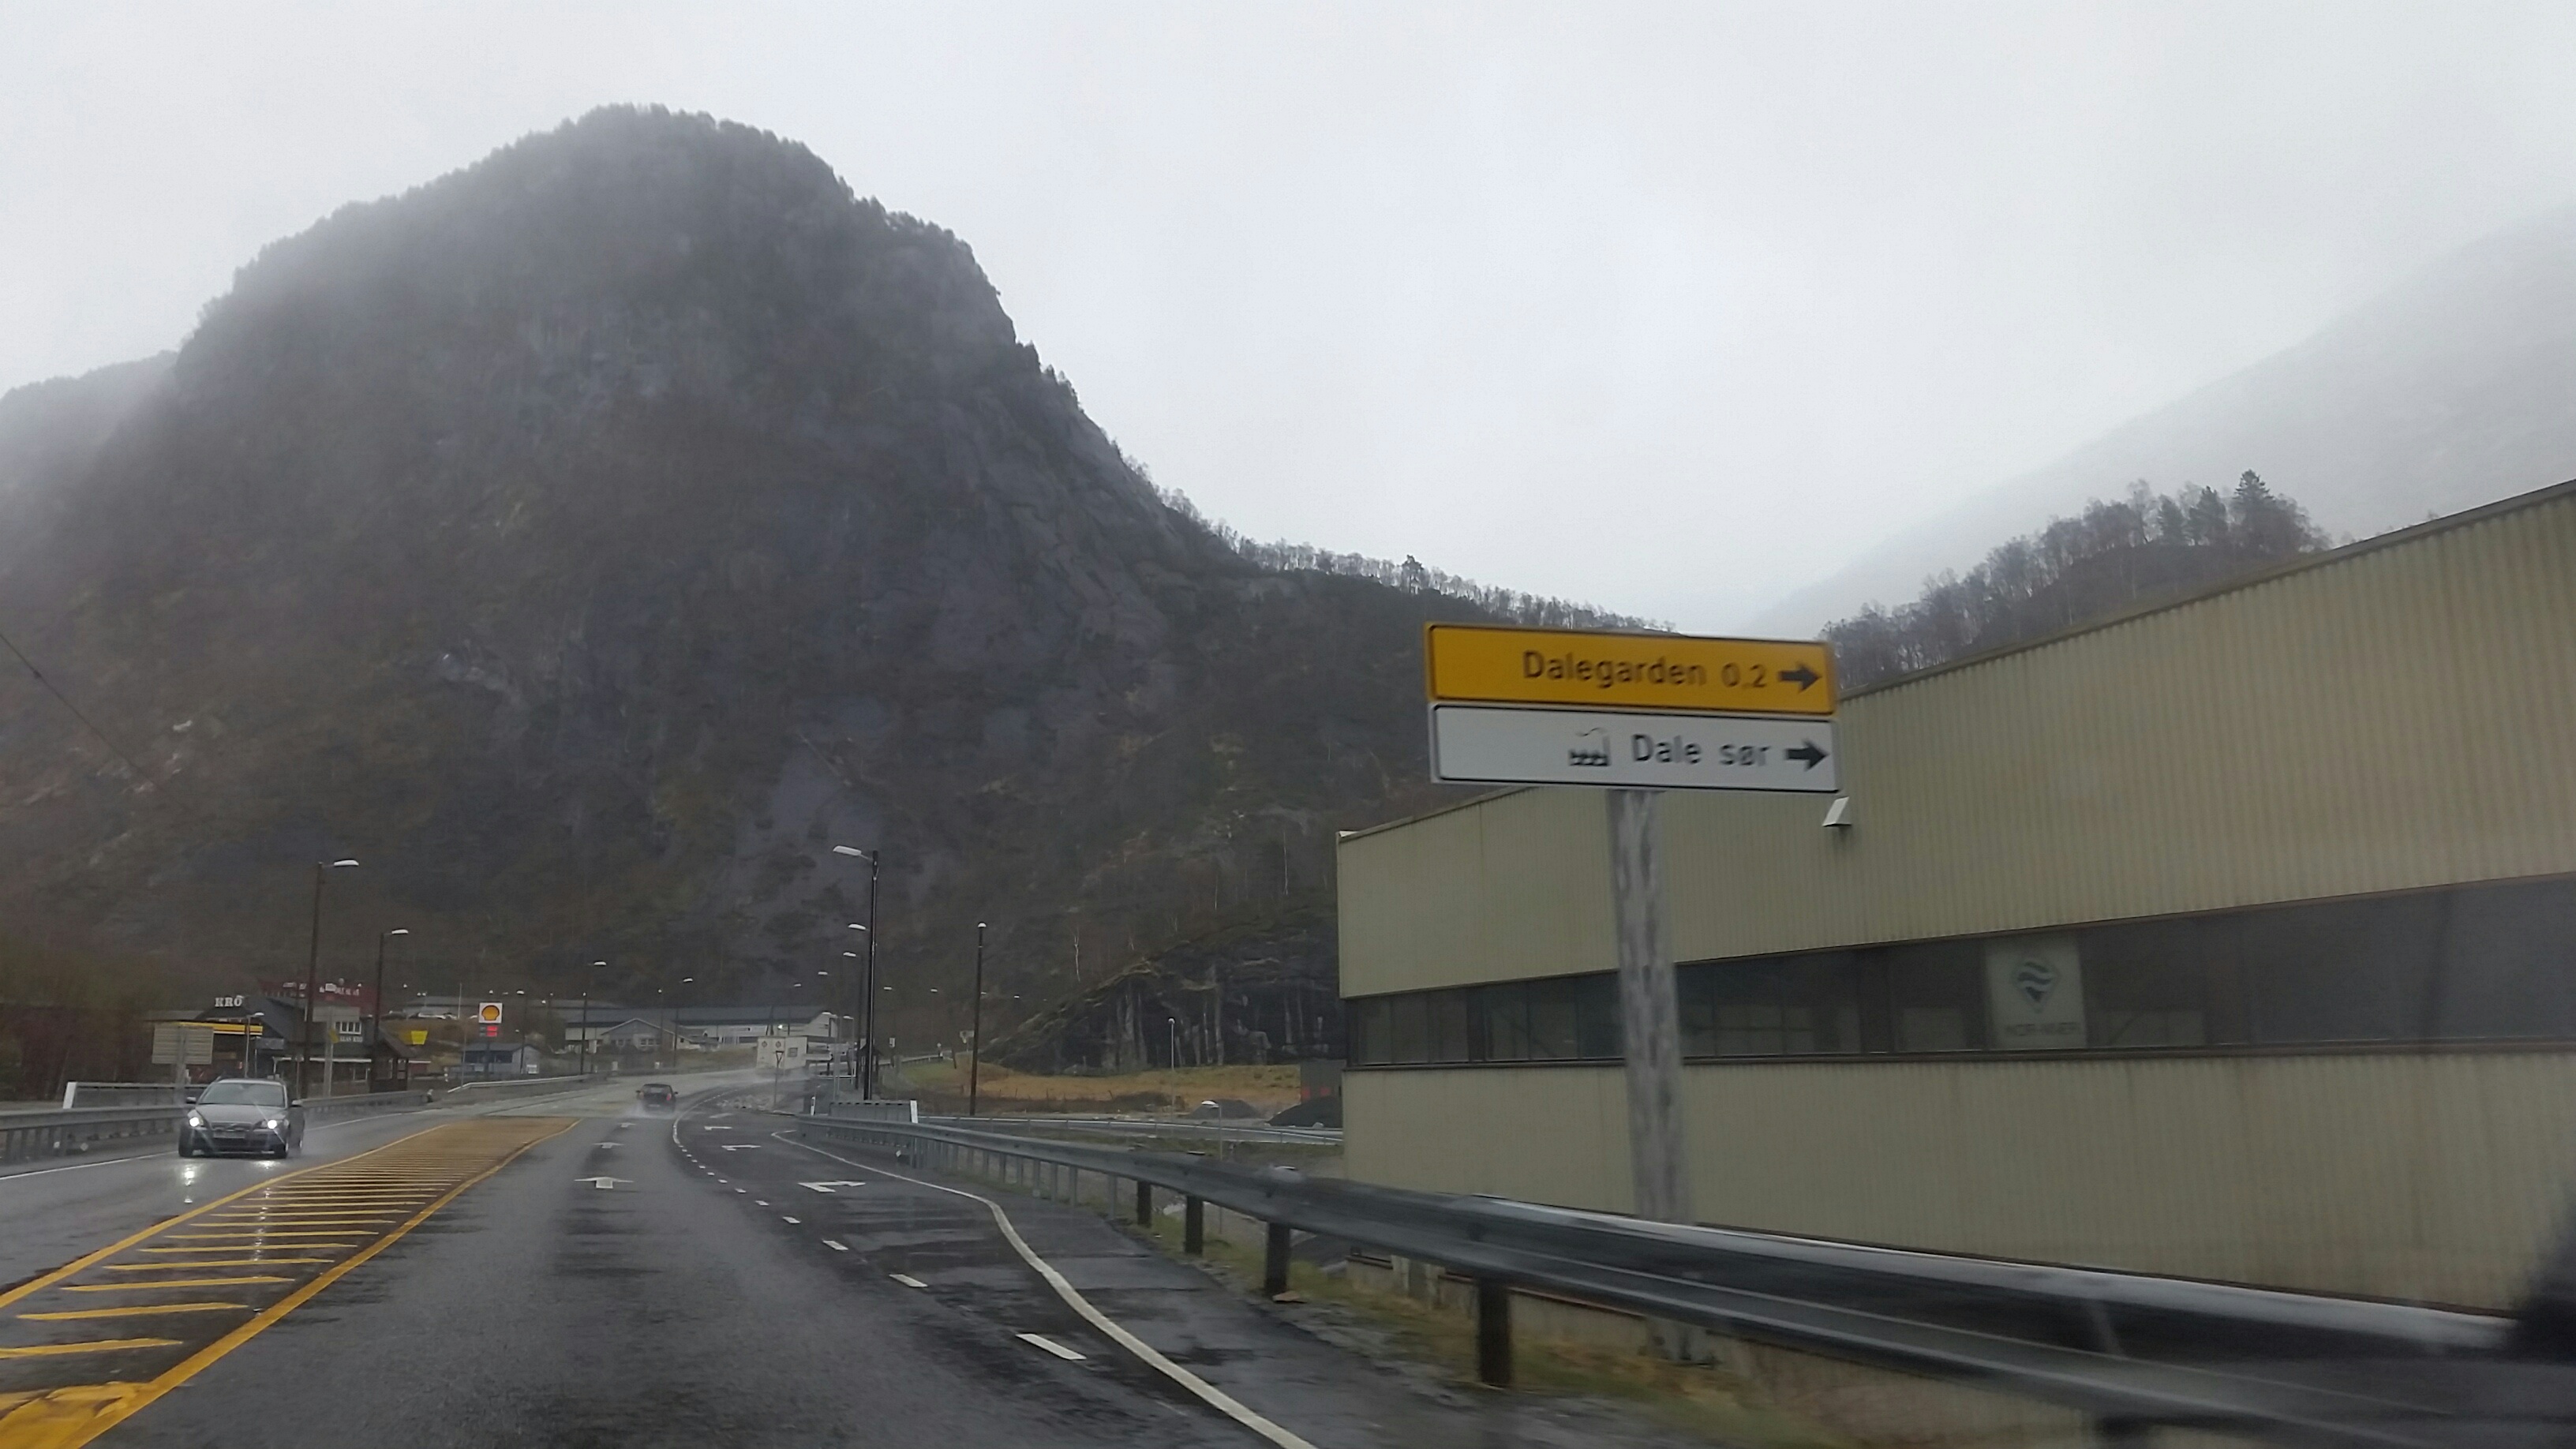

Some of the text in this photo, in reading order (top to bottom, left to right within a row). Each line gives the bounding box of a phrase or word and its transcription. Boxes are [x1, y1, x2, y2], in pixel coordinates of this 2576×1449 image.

[1522, 650, 1707, 689] Dalegarden
[1631, 733, 1770, 766] Dale sør
